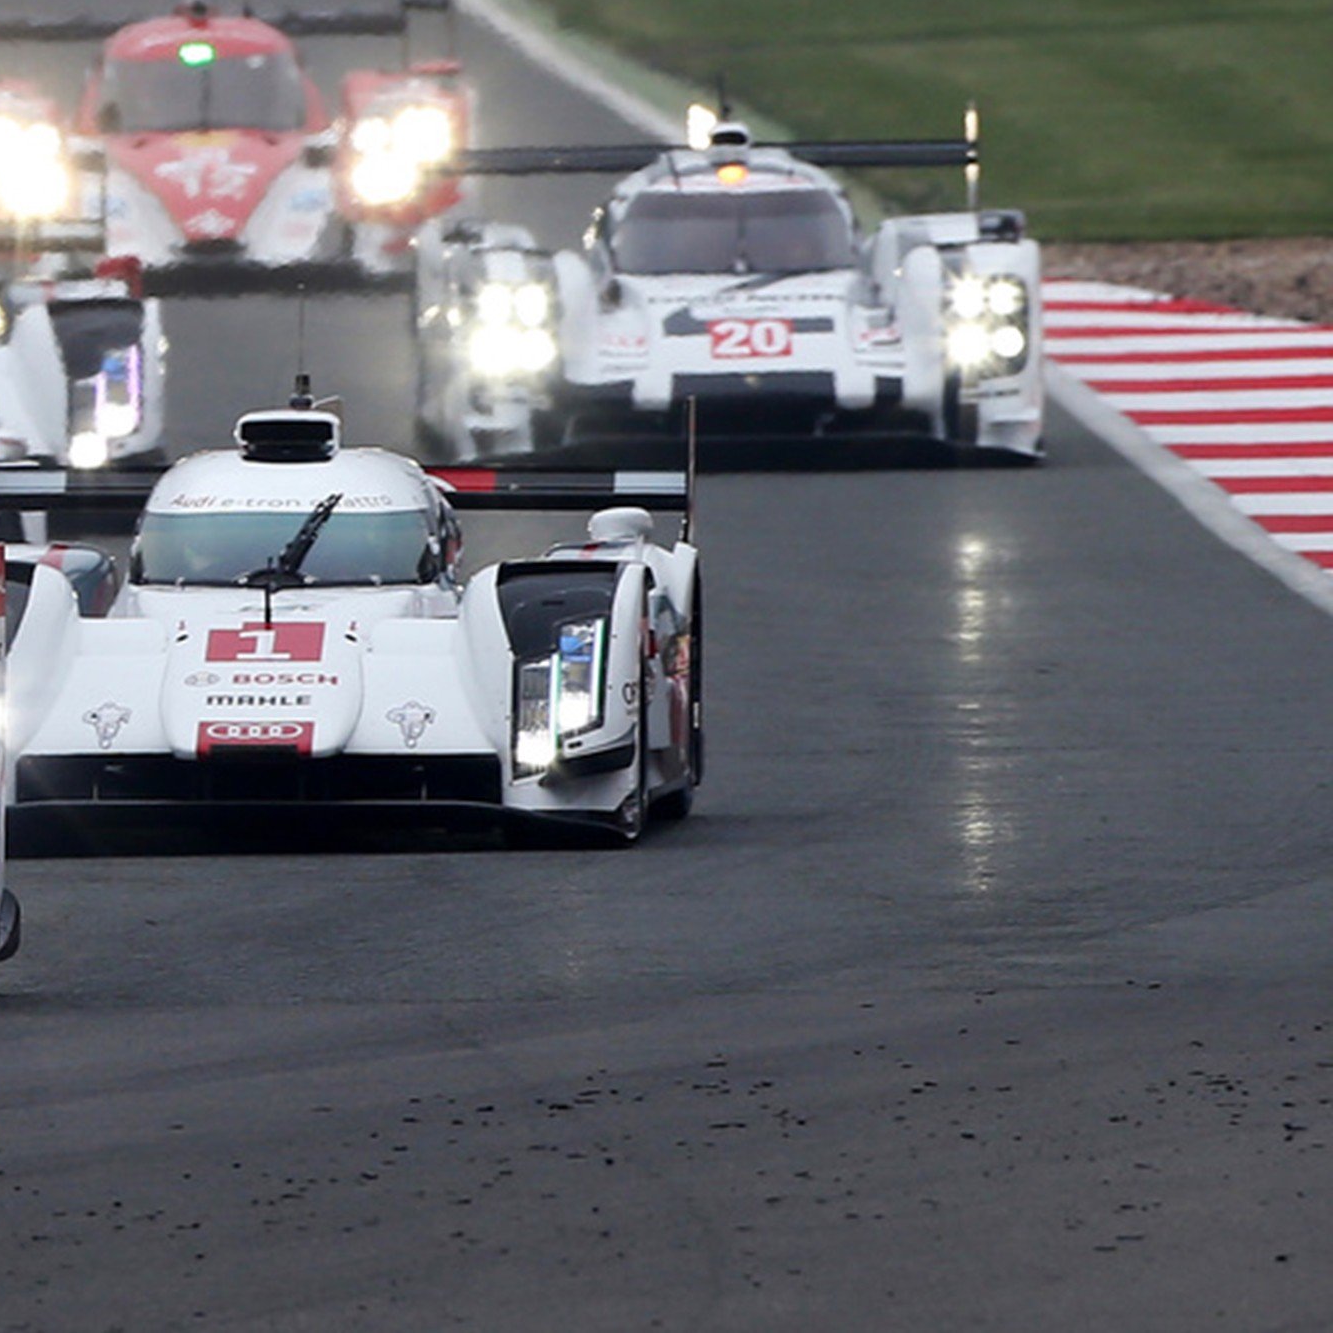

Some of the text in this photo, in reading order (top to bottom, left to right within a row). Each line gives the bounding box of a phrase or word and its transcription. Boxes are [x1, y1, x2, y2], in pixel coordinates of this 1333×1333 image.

[711, 321, 788, 354] 20
[170, 494, 214, 508] Audi
[309, 495, 393, 511] qattro
[236, 630, 291, 659] 1
[233, 673, 338, 686] BOSCH
[206, 695, 312, 706] MAHLE
